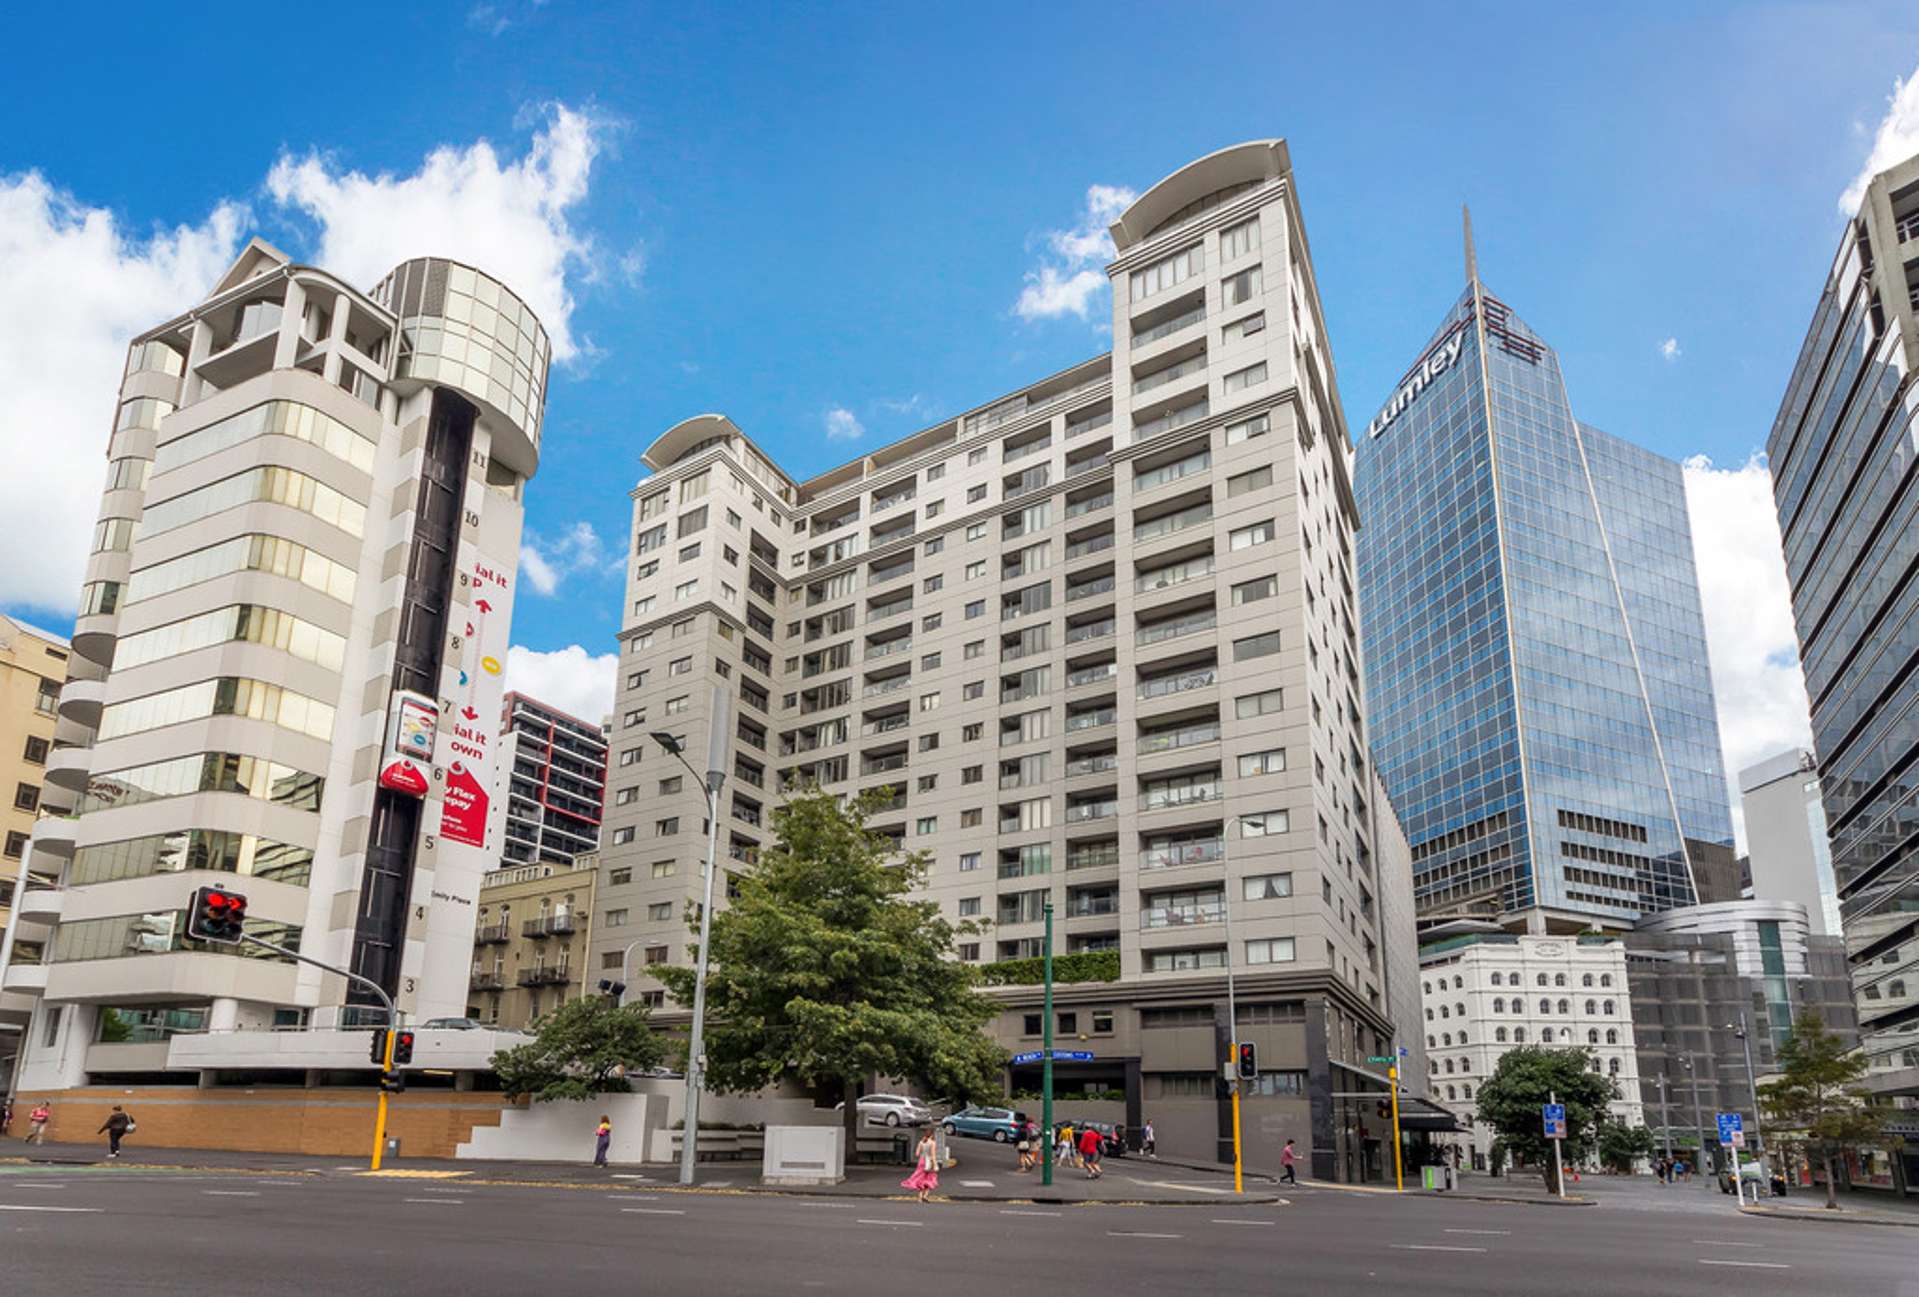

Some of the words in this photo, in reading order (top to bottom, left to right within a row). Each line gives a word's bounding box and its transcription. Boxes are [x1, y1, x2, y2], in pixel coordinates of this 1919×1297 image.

[1369, 329, 1465, 438] Lumley
[472, 452, 487, 469] 11
[465, 510, 479, 528] 10
[460, 573, 468, 587] 9
[451, 637, 460, 650] 8
[443, 701, 451, 714] 7
[434, 767, 443, 781] 6
[425, 836, 434, 850] 5
[415, 906, 424, 920] 4
[406, 978, 414, 993] 3
